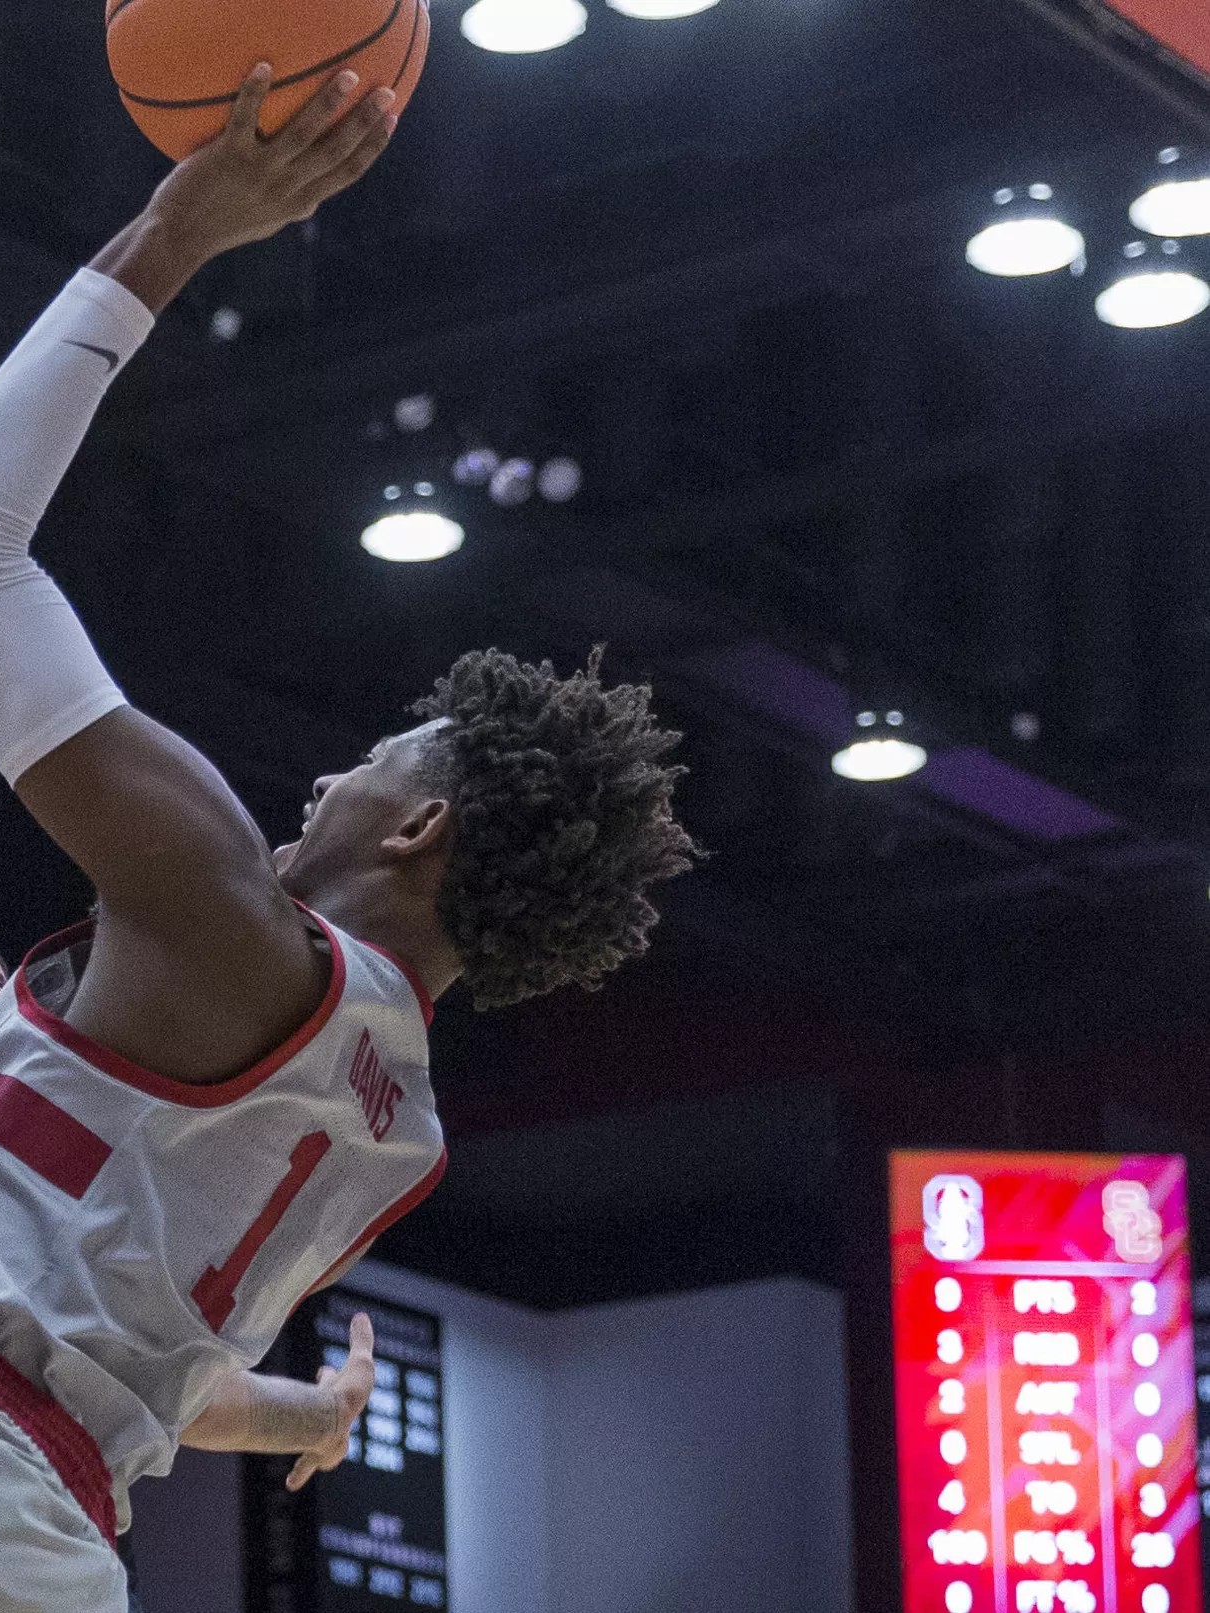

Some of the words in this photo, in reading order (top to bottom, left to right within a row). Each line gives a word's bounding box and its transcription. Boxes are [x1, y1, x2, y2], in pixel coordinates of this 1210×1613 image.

[348, 1026, 405, 1143] DAVIS
[191, 1130, 332, 1334] 1
[938, 1480, 966, 1515] 4
[1025, 1480, 1078, 1515] TO
